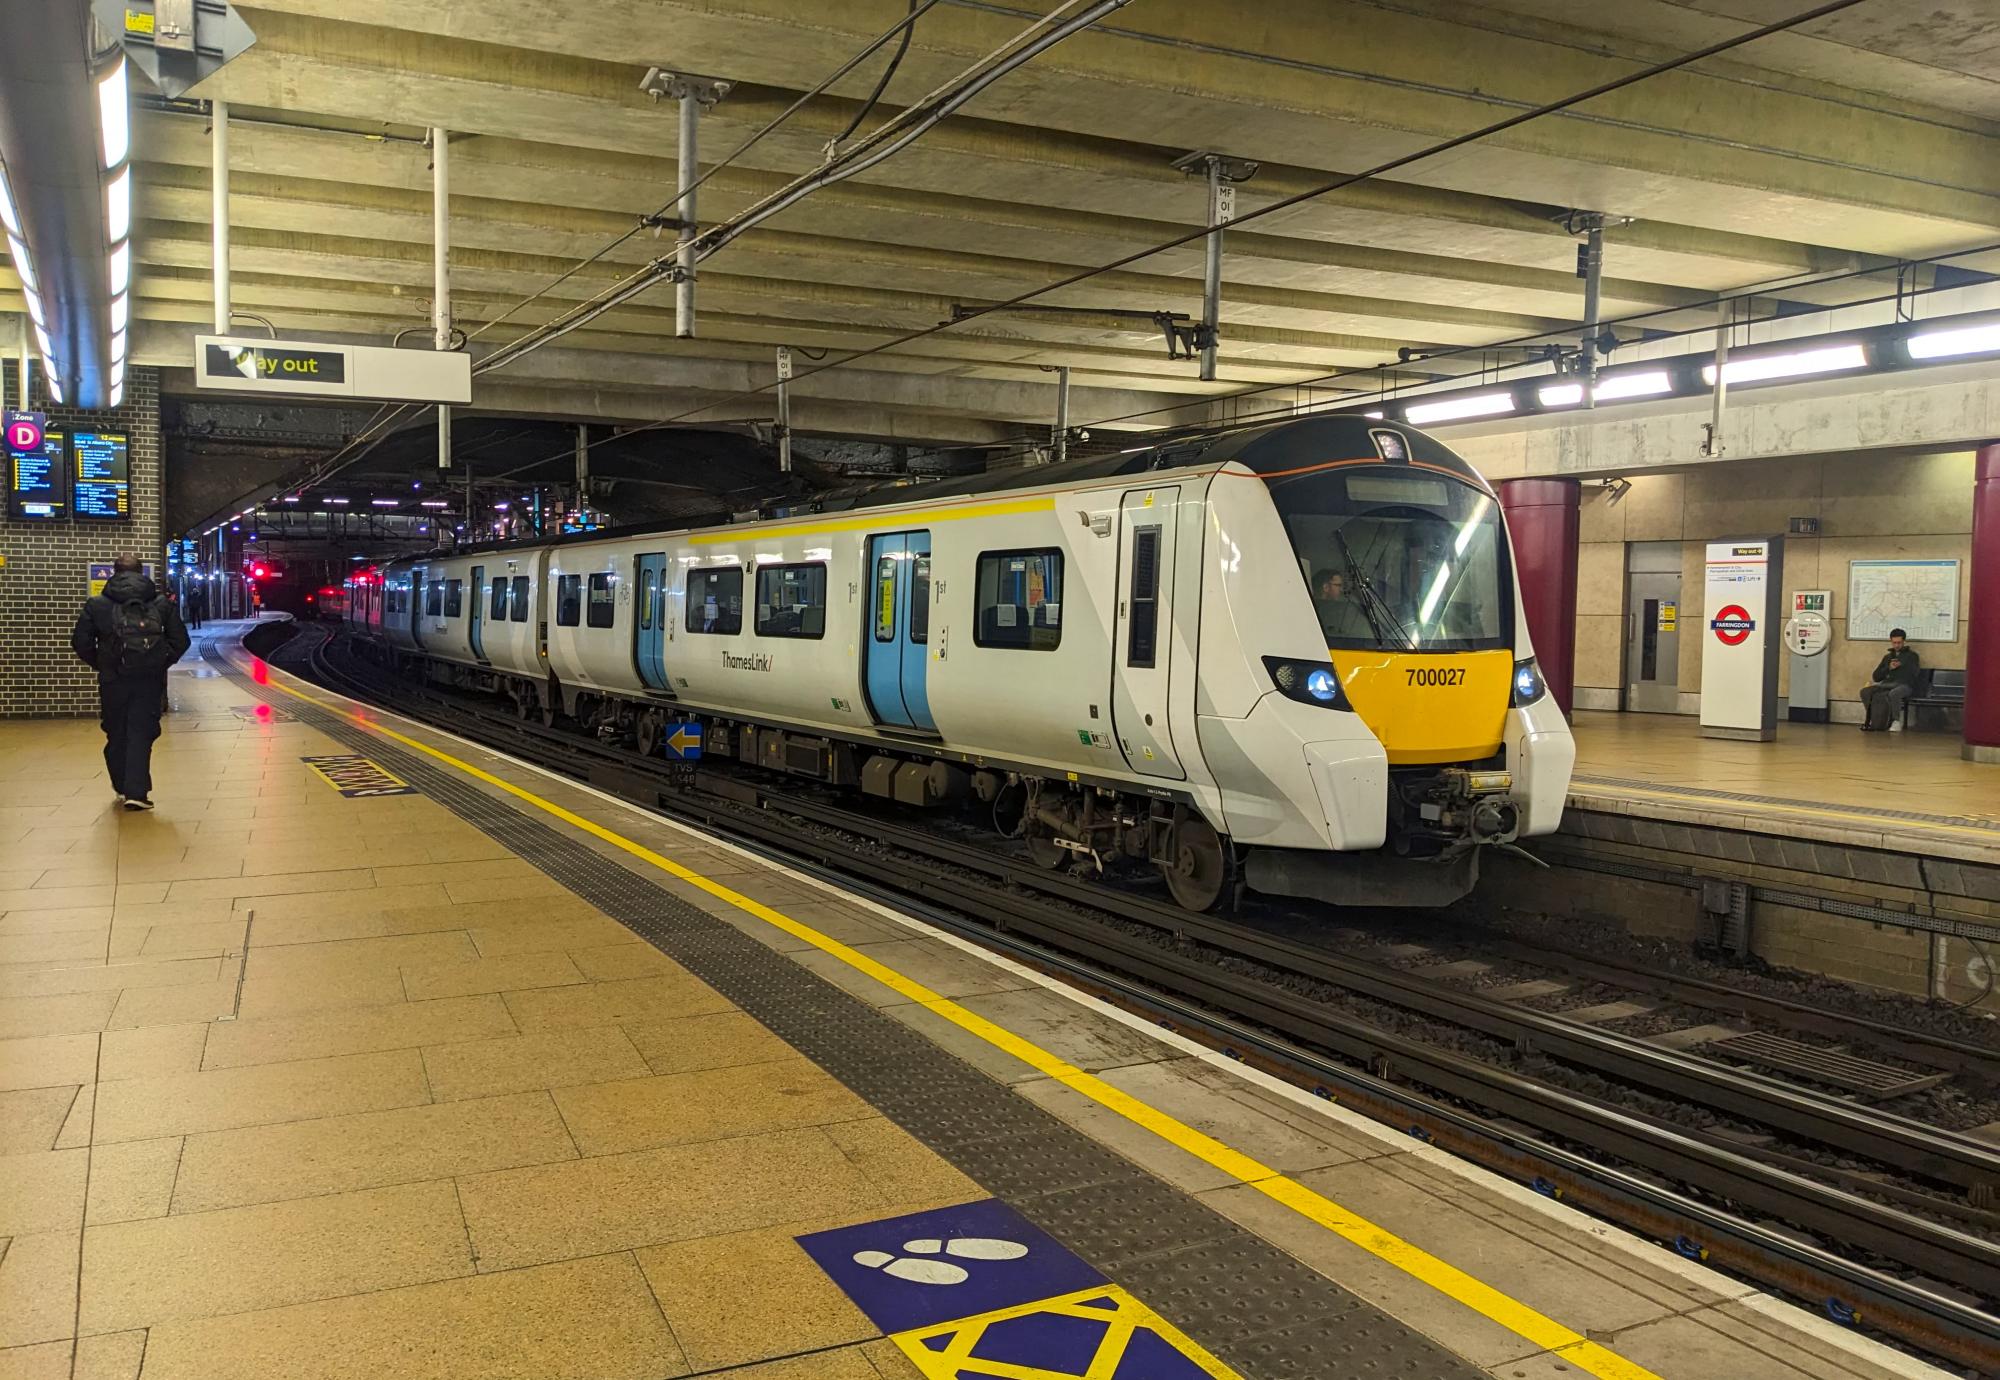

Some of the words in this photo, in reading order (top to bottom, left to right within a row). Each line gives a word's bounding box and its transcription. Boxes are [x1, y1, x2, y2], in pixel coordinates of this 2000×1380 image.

[1220, 188, 1232, 197] MF
[282, 357, 318, 373] out
[17, 427, 34, 445] D
[847, 582, 858, 604] 1st
[935, 580, 947, 604] 1st
[1405, 668, 1466, 686] 700027
